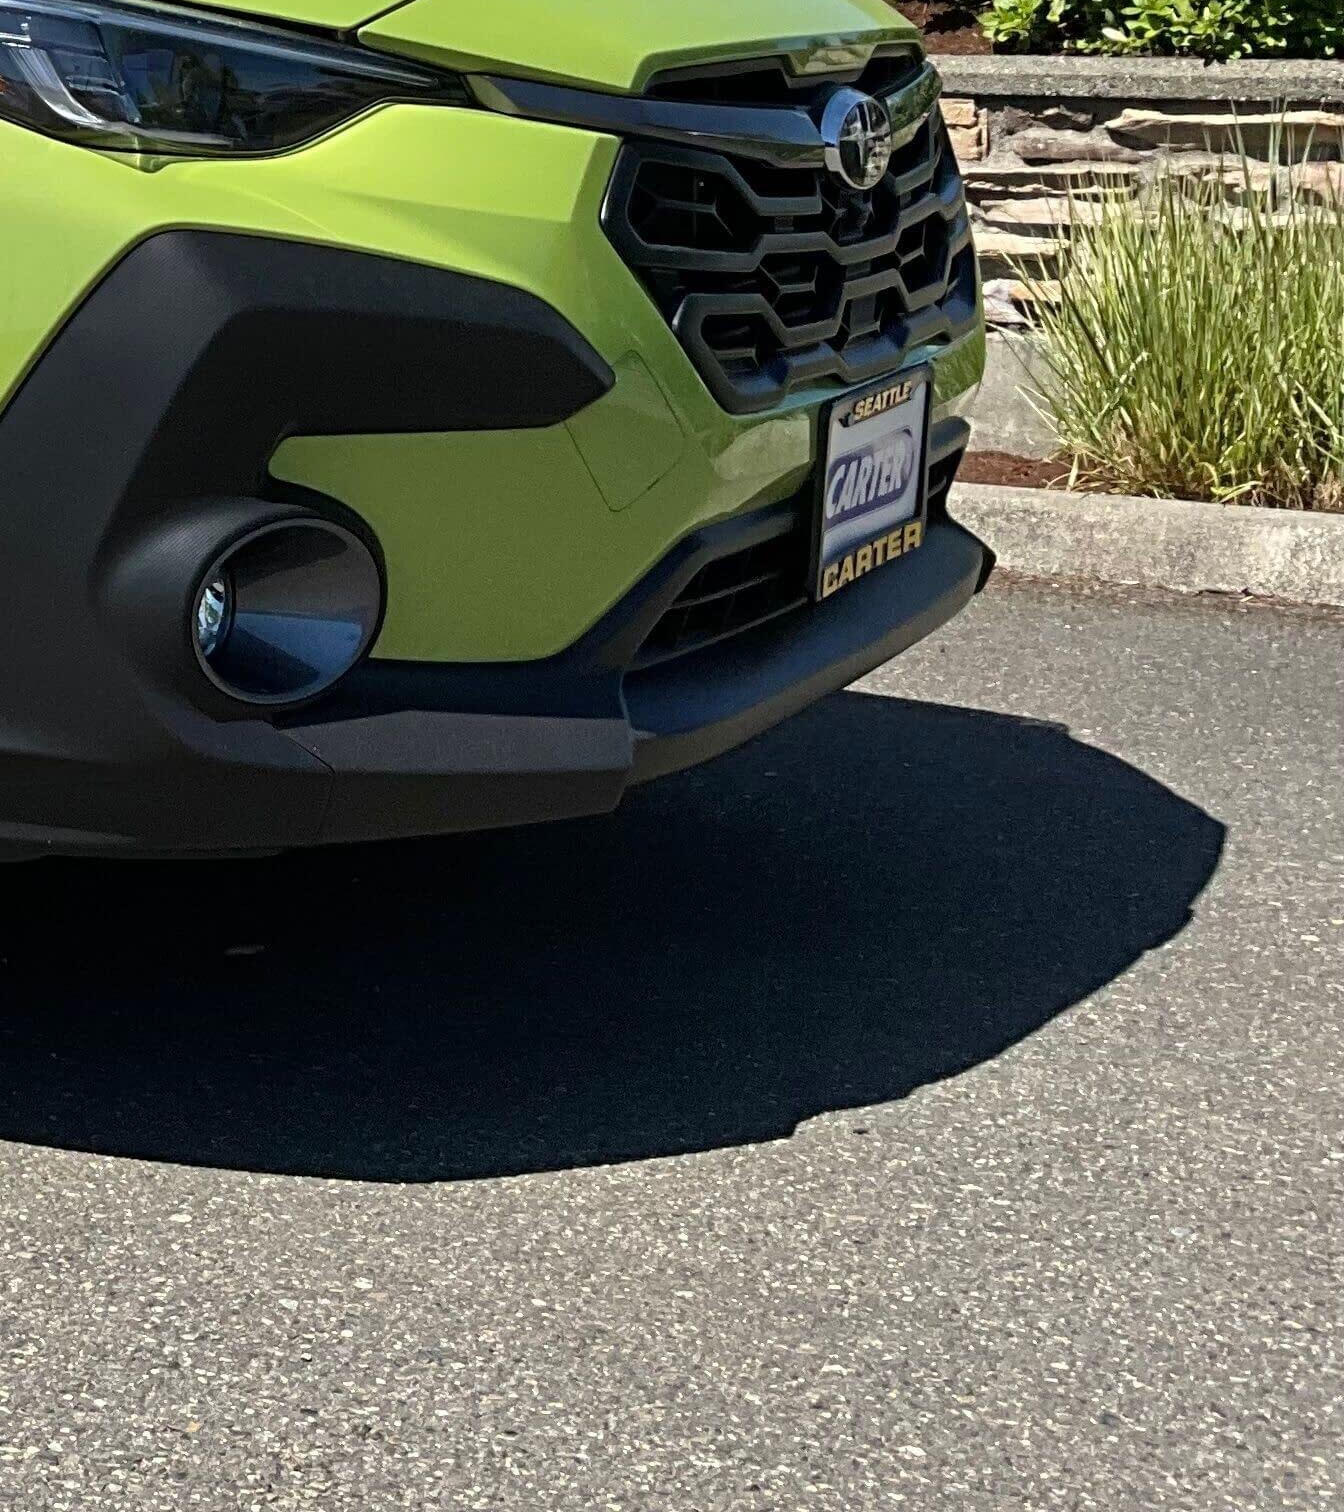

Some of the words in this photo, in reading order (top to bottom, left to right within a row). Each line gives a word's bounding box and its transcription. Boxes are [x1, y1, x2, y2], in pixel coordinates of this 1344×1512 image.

[854, 380, 912, 420] SEATTLE
[826, 439, 906, 519] CARTER
[822, 522, 922, 598] CARTER
